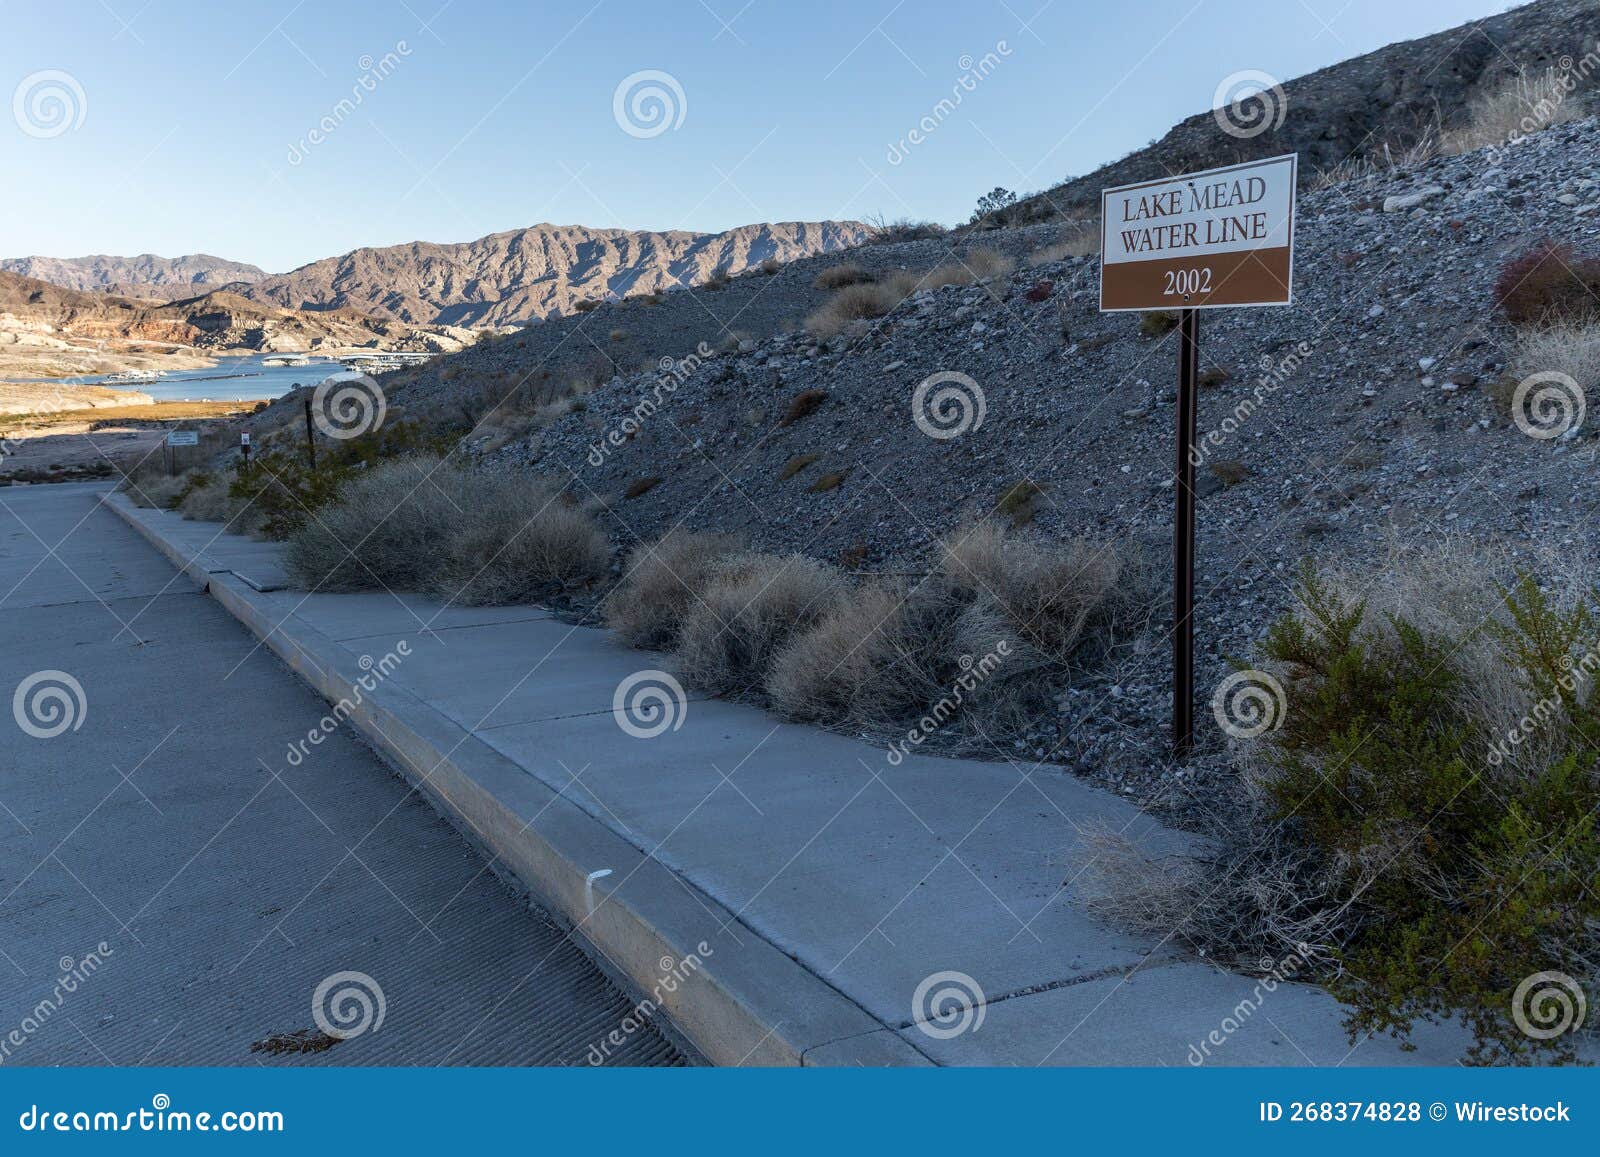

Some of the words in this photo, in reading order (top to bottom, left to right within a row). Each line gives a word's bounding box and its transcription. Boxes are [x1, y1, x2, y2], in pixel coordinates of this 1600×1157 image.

[1123, 190, 1183, 222] LAKE
[1188, 177, 1266, 213] MEAD
[1121, 222, 1200, 254] WATER
[1205, 212, 1267, 245] LINE
[1163, 267, 1213, 295] 2002
